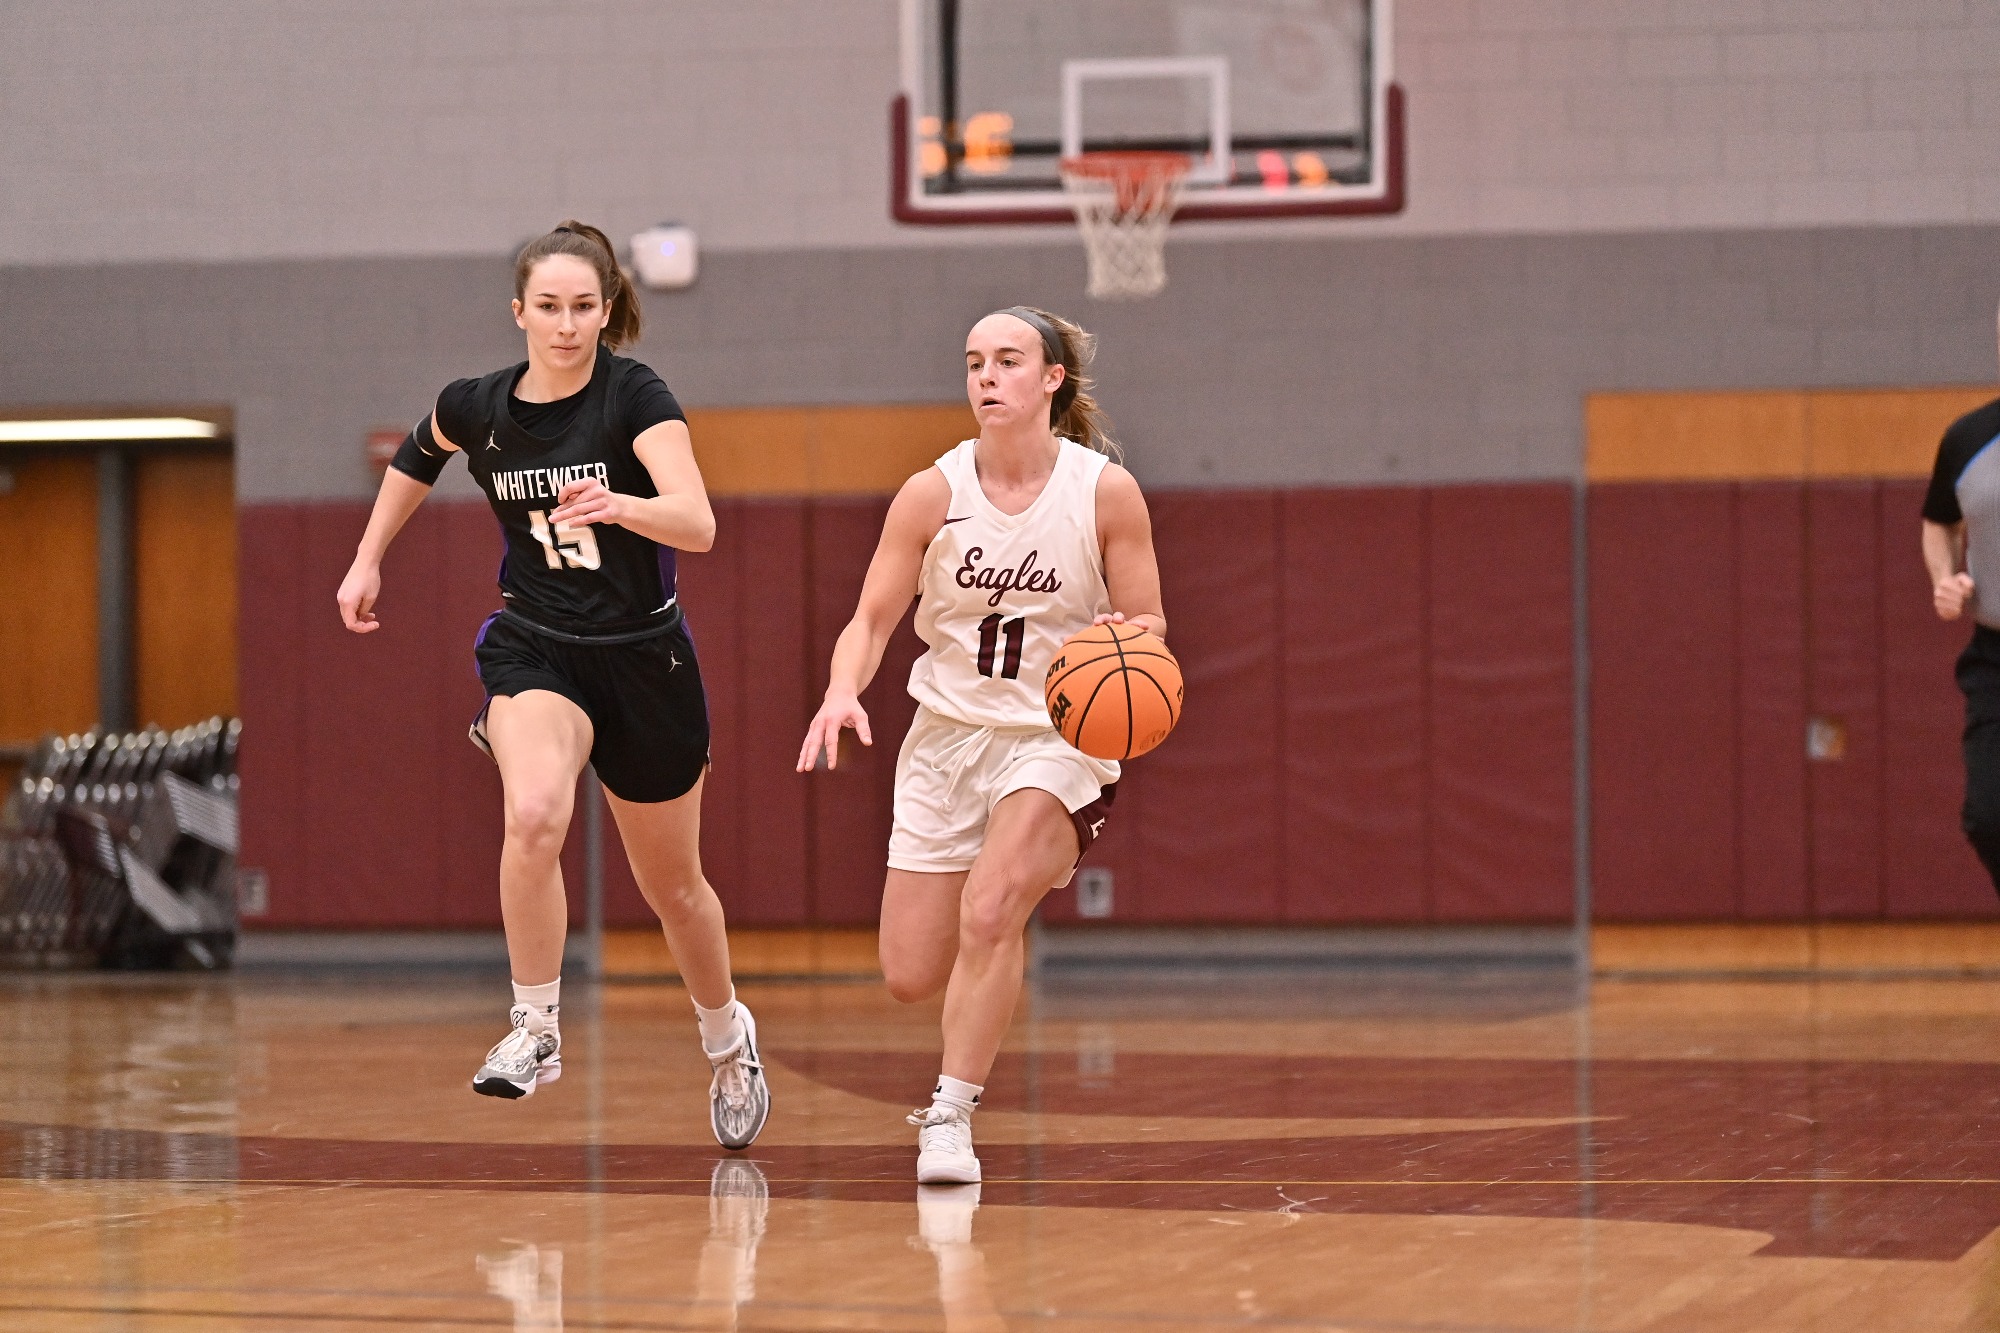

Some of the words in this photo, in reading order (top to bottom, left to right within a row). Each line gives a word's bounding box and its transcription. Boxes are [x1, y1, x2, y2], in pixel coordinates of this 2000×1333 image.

[528, 509, 601, 570] 15
[955, 546, 1062, 607] Eagles
[977, 613, 1025, 680] 11
